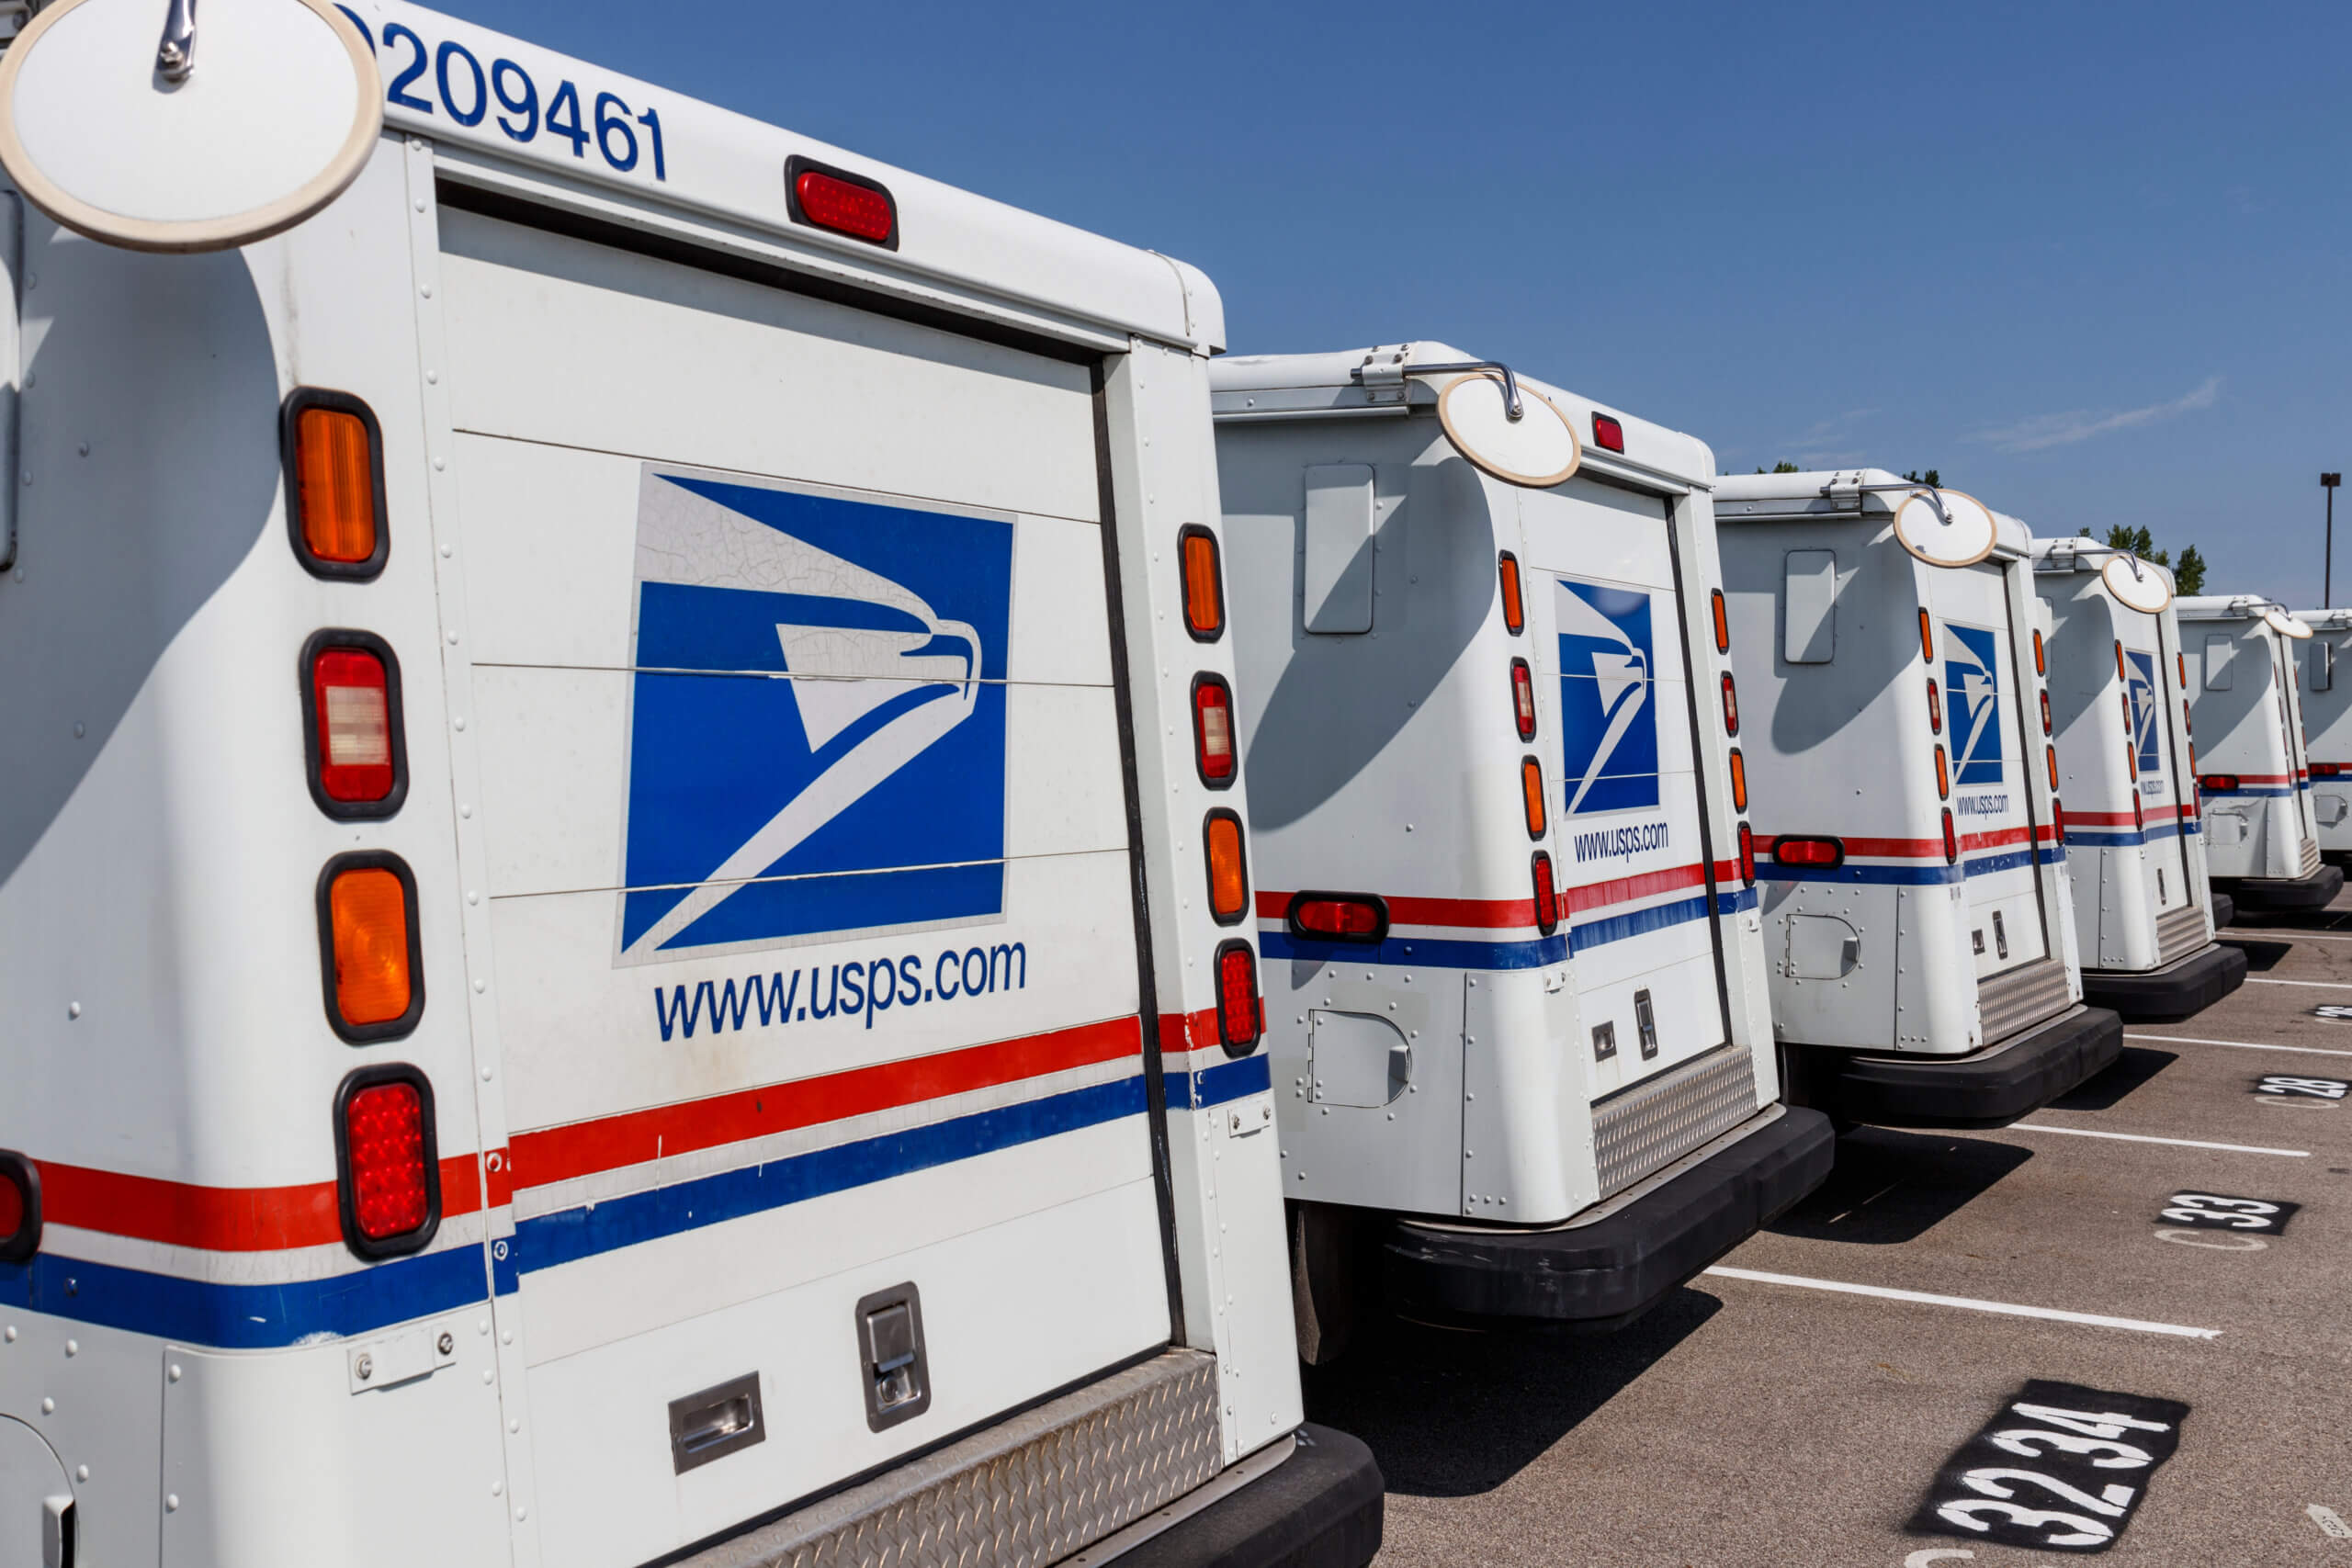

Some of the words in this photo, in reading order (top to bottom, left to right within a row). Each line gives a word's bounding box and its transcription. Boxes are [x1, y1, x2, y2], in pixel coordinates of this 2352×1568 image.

[335, 4, 665, 181] 209461
[1574, 822, 1668, 863] www.usps.com
[654, 942, 1026, 1042] www.usps.com
[2258, 1077, 2348, 1099] 28
[2161, 1194, 2280, 1228] 33
